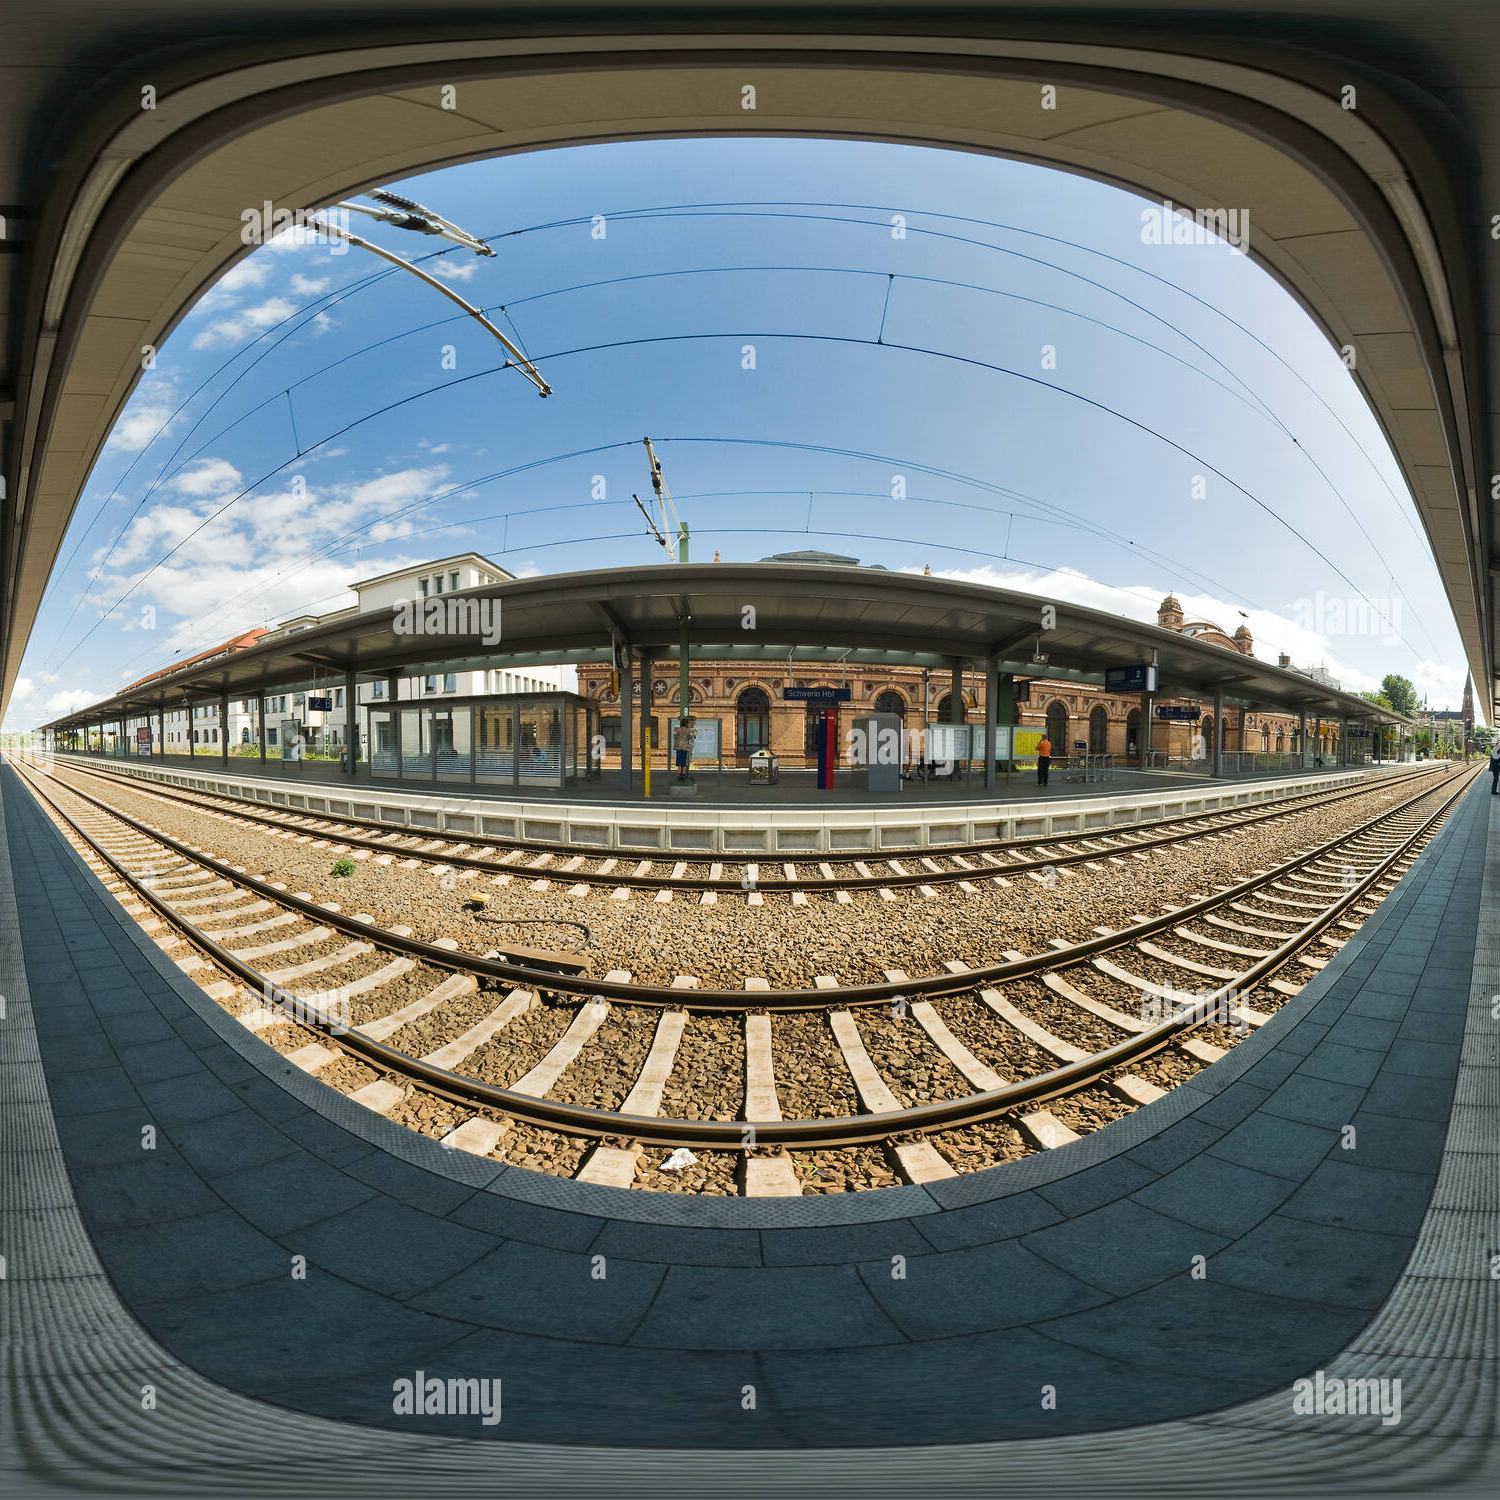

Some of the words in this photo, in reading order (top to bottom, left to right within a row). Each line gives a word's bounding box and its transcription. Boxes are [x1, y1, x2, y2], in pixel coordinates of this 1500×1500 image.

[1135, 670, 1141, 678] 2
[787, 689, 820, 698] Schwerin
[821, 690, 835, 698] Hbf
[314, 698, 321, 709] 2
[325, 698, 332, 709] B
